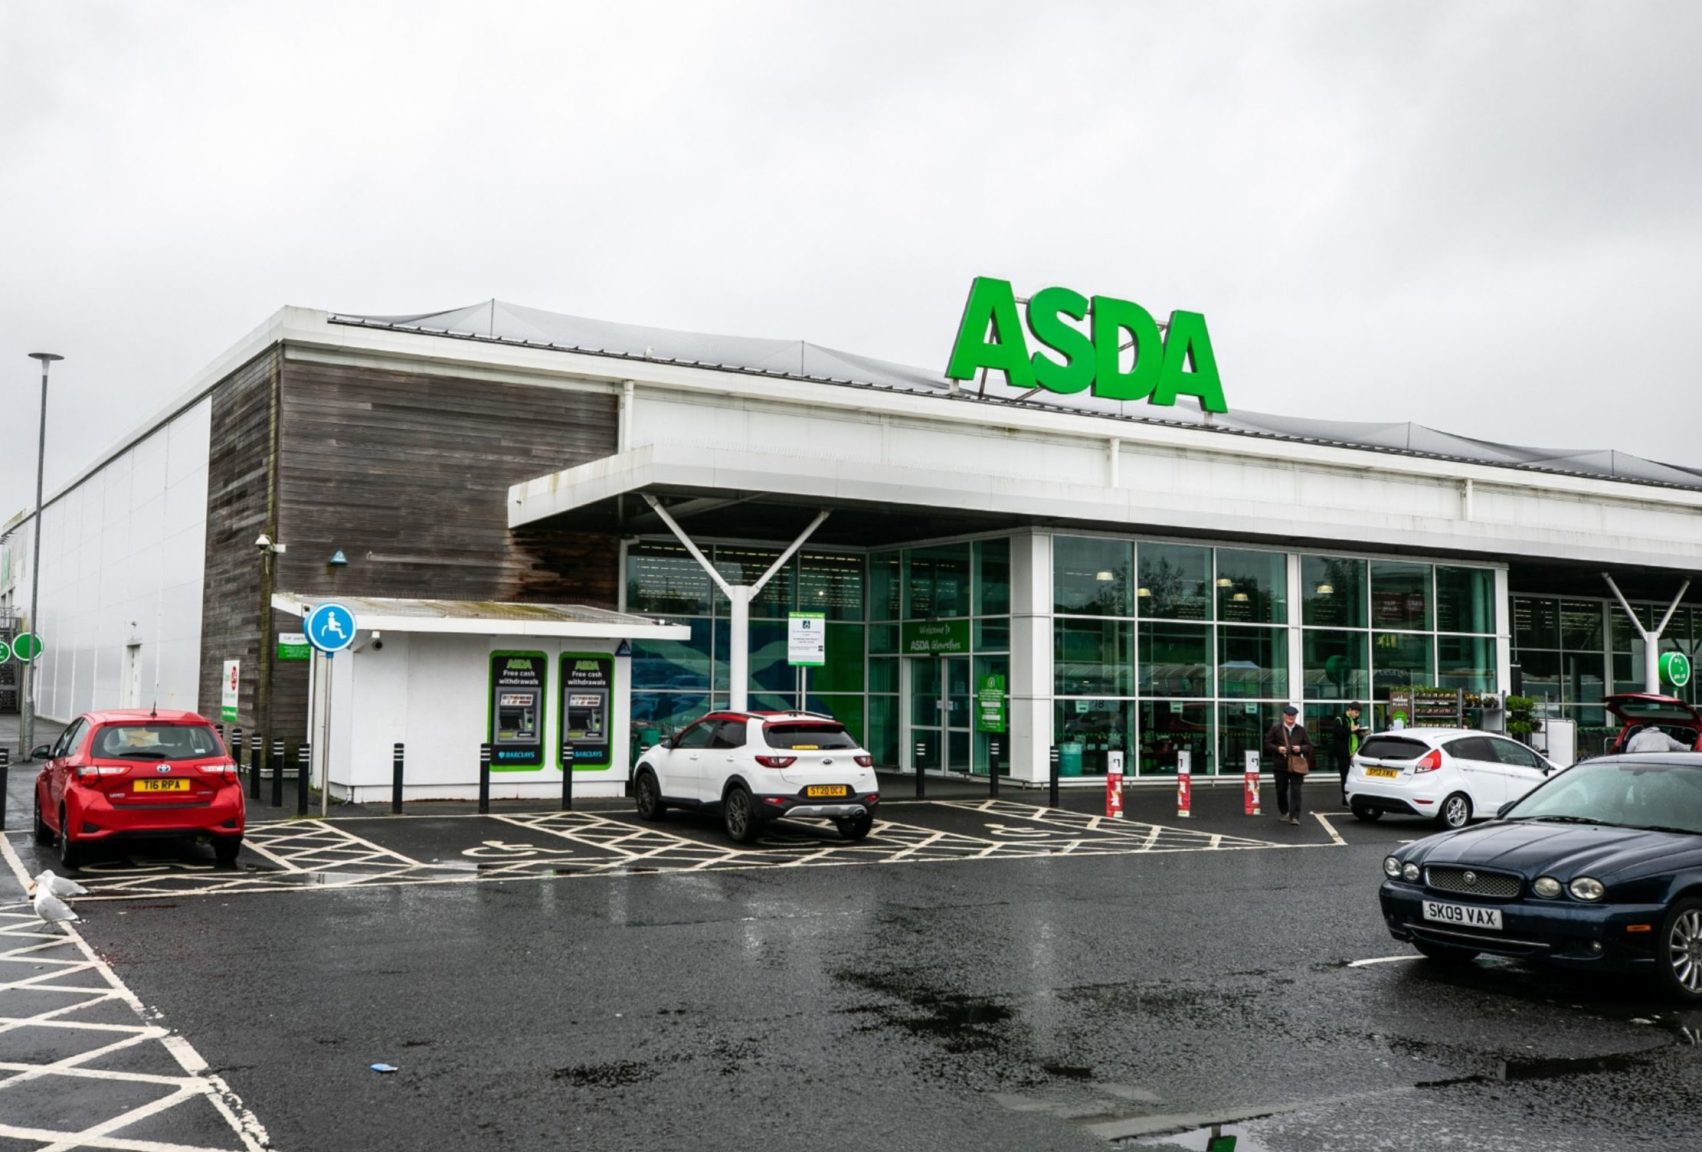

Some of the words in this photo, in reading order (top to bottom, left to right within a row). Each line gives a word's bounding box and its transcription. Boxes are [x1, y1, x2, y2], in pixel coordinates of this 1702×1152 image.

[944, 276, 1228, 413] ASDA
[910, 640, 930, 651] ASDA
[506, 659, 533, 669] ASDA
[574, 660, 600, 670] ASDA
[144, 780, 159, 789] T16
[161, 780, 180, 789] RPA
[1429, 903, 1463, 921] SK09
[1466, 908, 1495, 926] VAX
